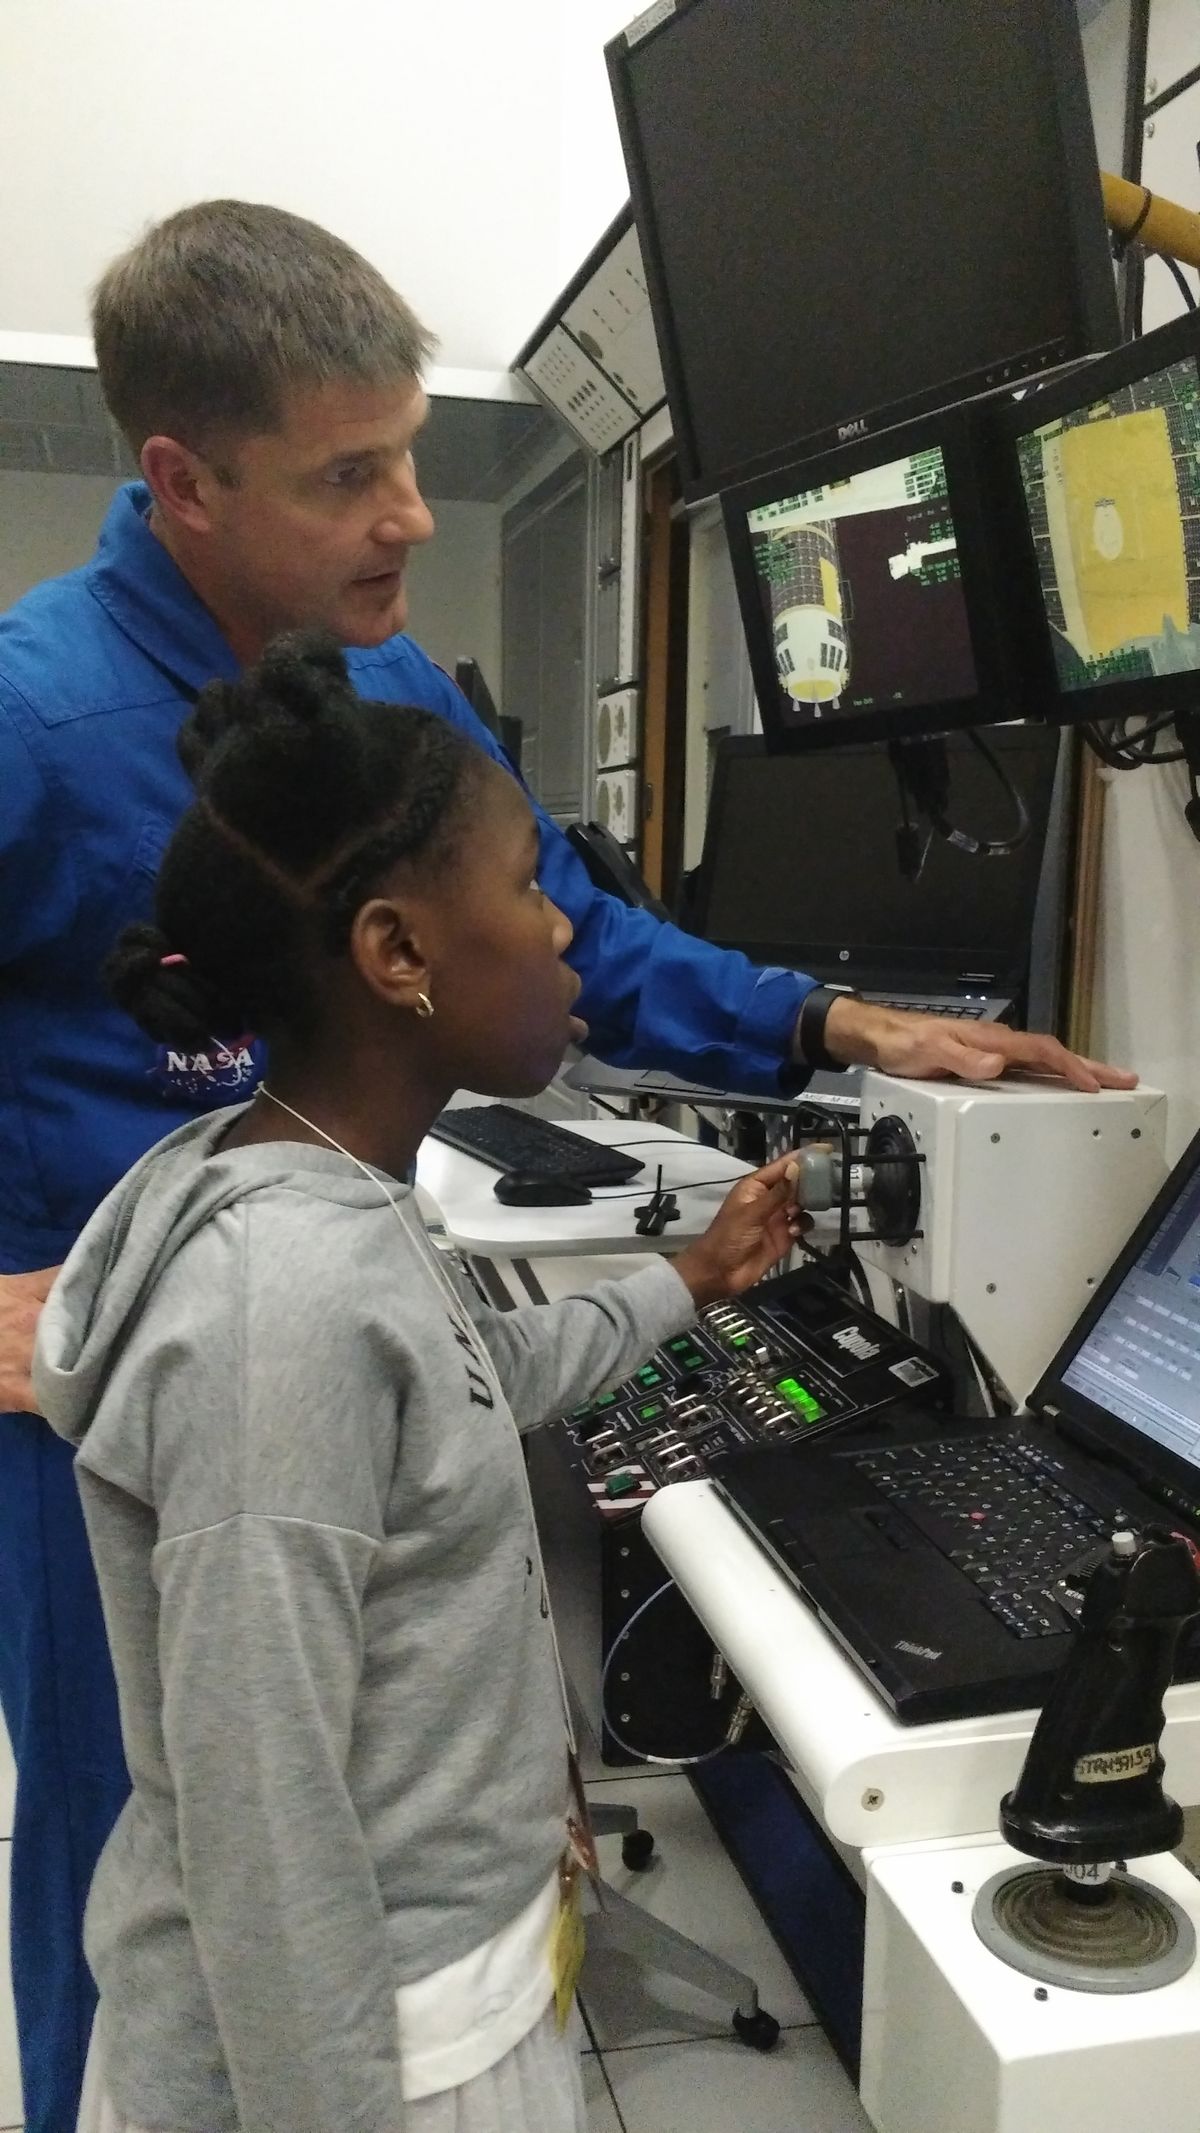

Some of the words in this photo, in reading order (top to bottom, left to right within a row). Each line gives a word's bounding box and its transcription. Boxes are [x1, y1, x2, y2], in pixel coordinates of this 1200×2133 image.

[838, 419, 868, 440] DELL
[166, 1046, 255, 1072] NASA
[832, 1325, 881, 1361] Cupola
[894, 1640, 943, 1660] ThinkPad
